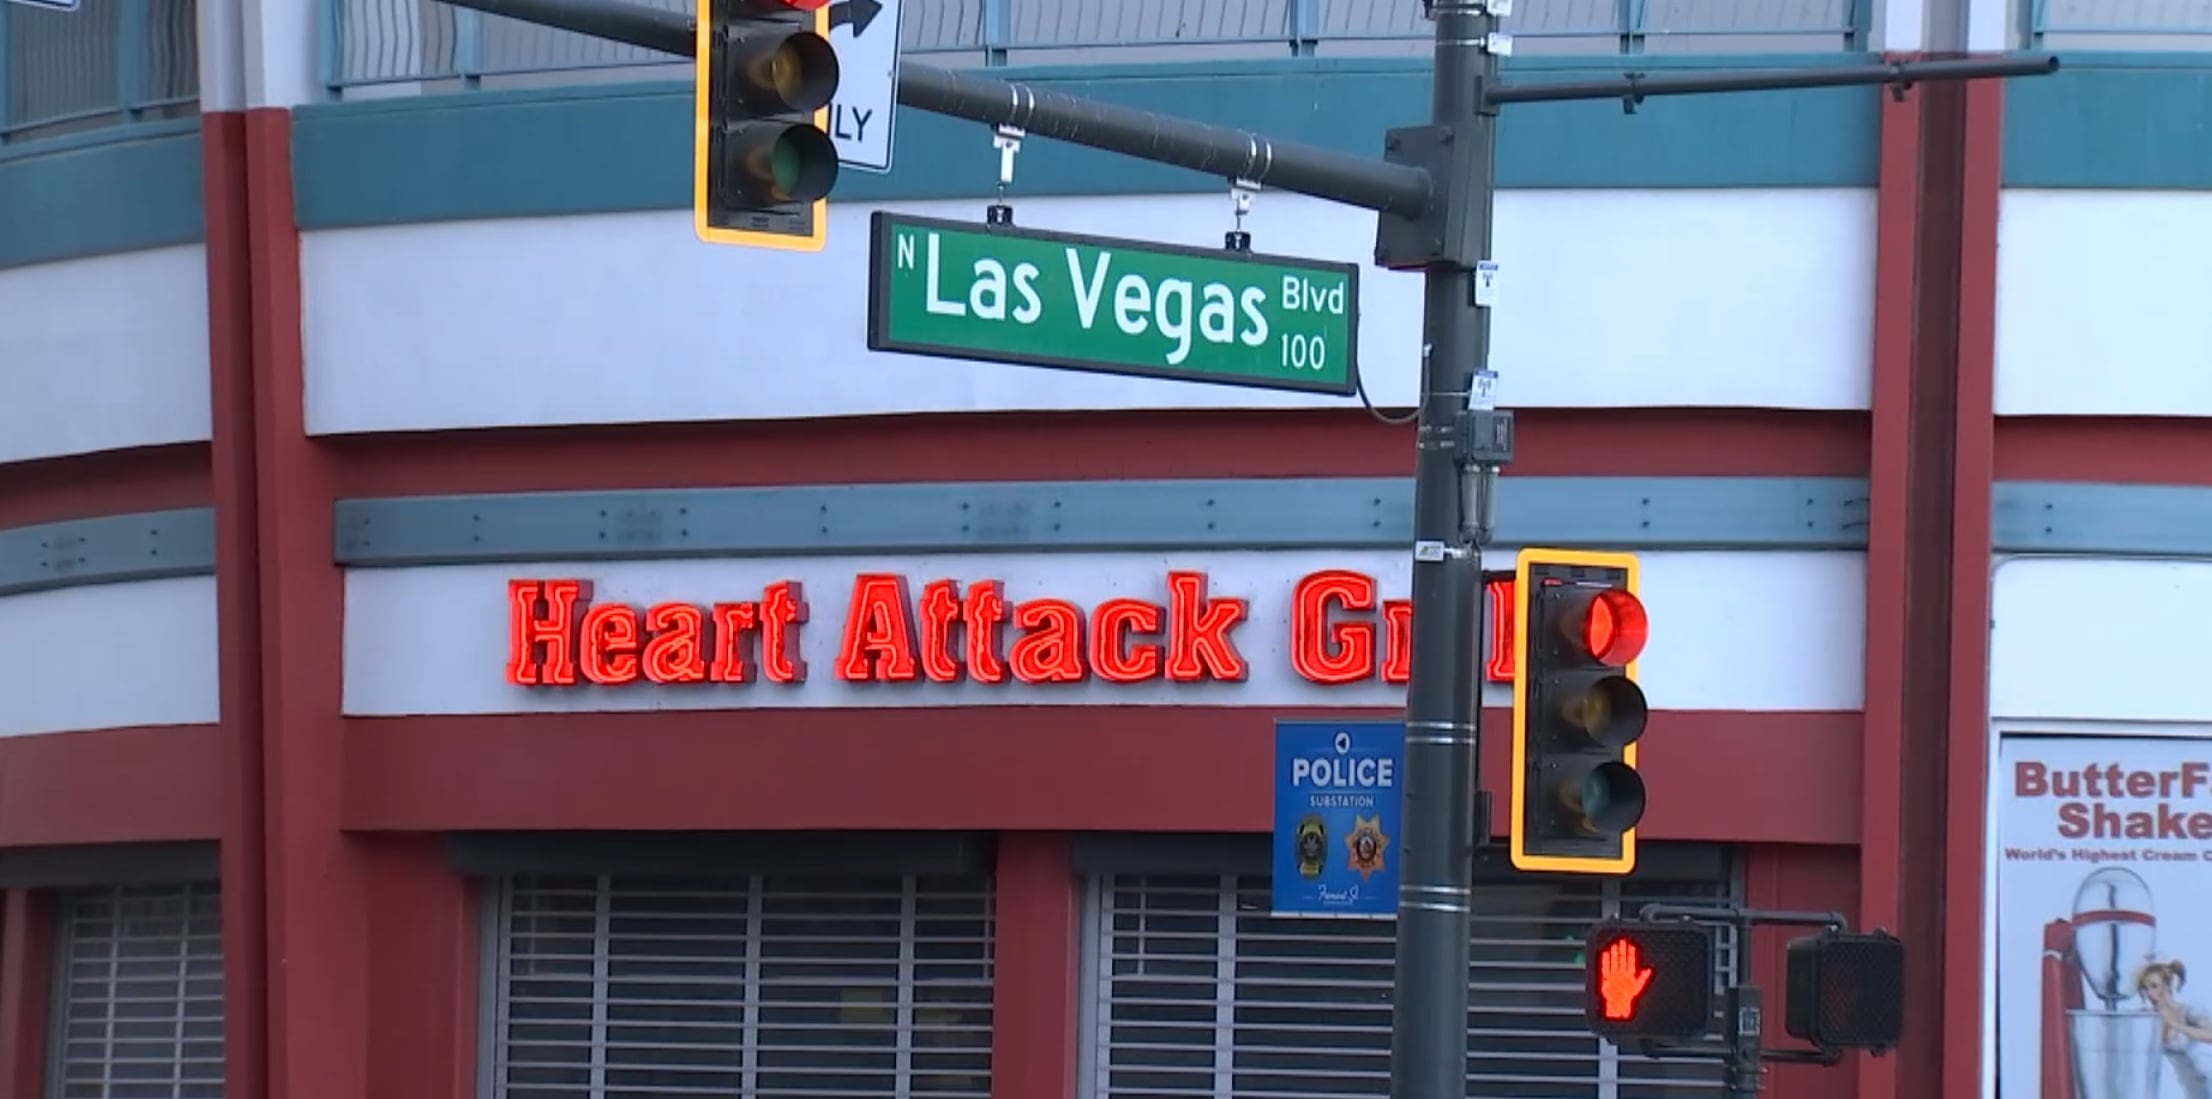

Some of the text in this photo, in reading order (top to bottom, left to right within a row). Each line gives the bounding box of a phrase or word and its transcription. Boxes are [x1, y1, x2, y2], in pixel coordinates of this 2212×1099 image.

[829, 103, 872, 142] LY
[897, 232, 1345, 365] N Las Vegas Blvd
[1281, 333, 1326, 370] 100
[506, 568, 1516, 686] Heart Attack Grl
[1292, 758, 1393, 787] POLICE
[2014, 761, 2212, 799] ButterF
[1309, 794, 1375, 808] SUBSTATION
[2005, 848, 2067, 861] World's
[2071, 848, 2138, 864] Highest
[2142, 849, 2198, 862] Cream
